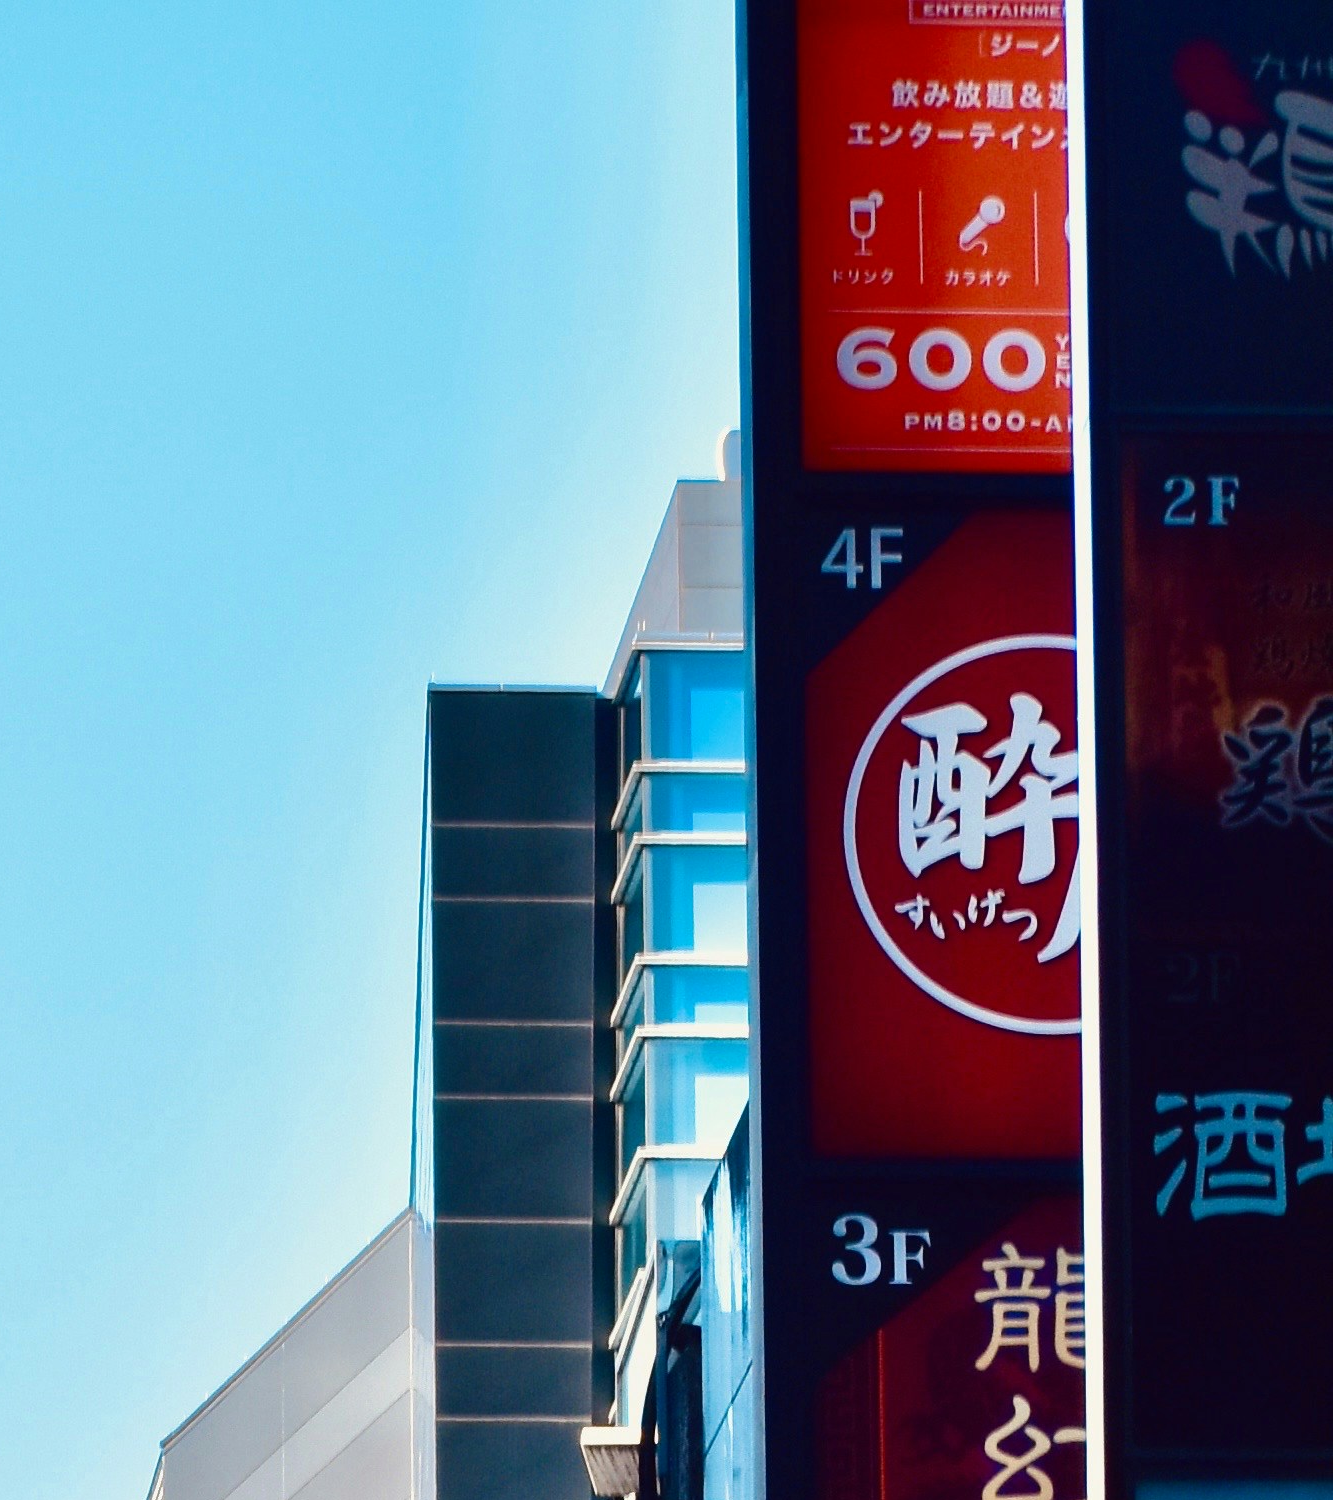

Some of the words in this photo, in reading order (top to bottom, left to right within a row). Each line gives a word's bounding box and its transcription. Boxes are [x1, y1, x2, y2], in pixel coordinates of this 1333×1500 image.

[831, 266, 897, 287] ドリンク
[944, 266, 1014, 289] カラオケ
[836, 325, 1047, 391] 600
[1162, 474, 1242, 527] 2F
[820, 526, 905, 590] 4F
[893, 889, 1039, 943] すいげつ
[830, 1213, 932, 1287] 3F
